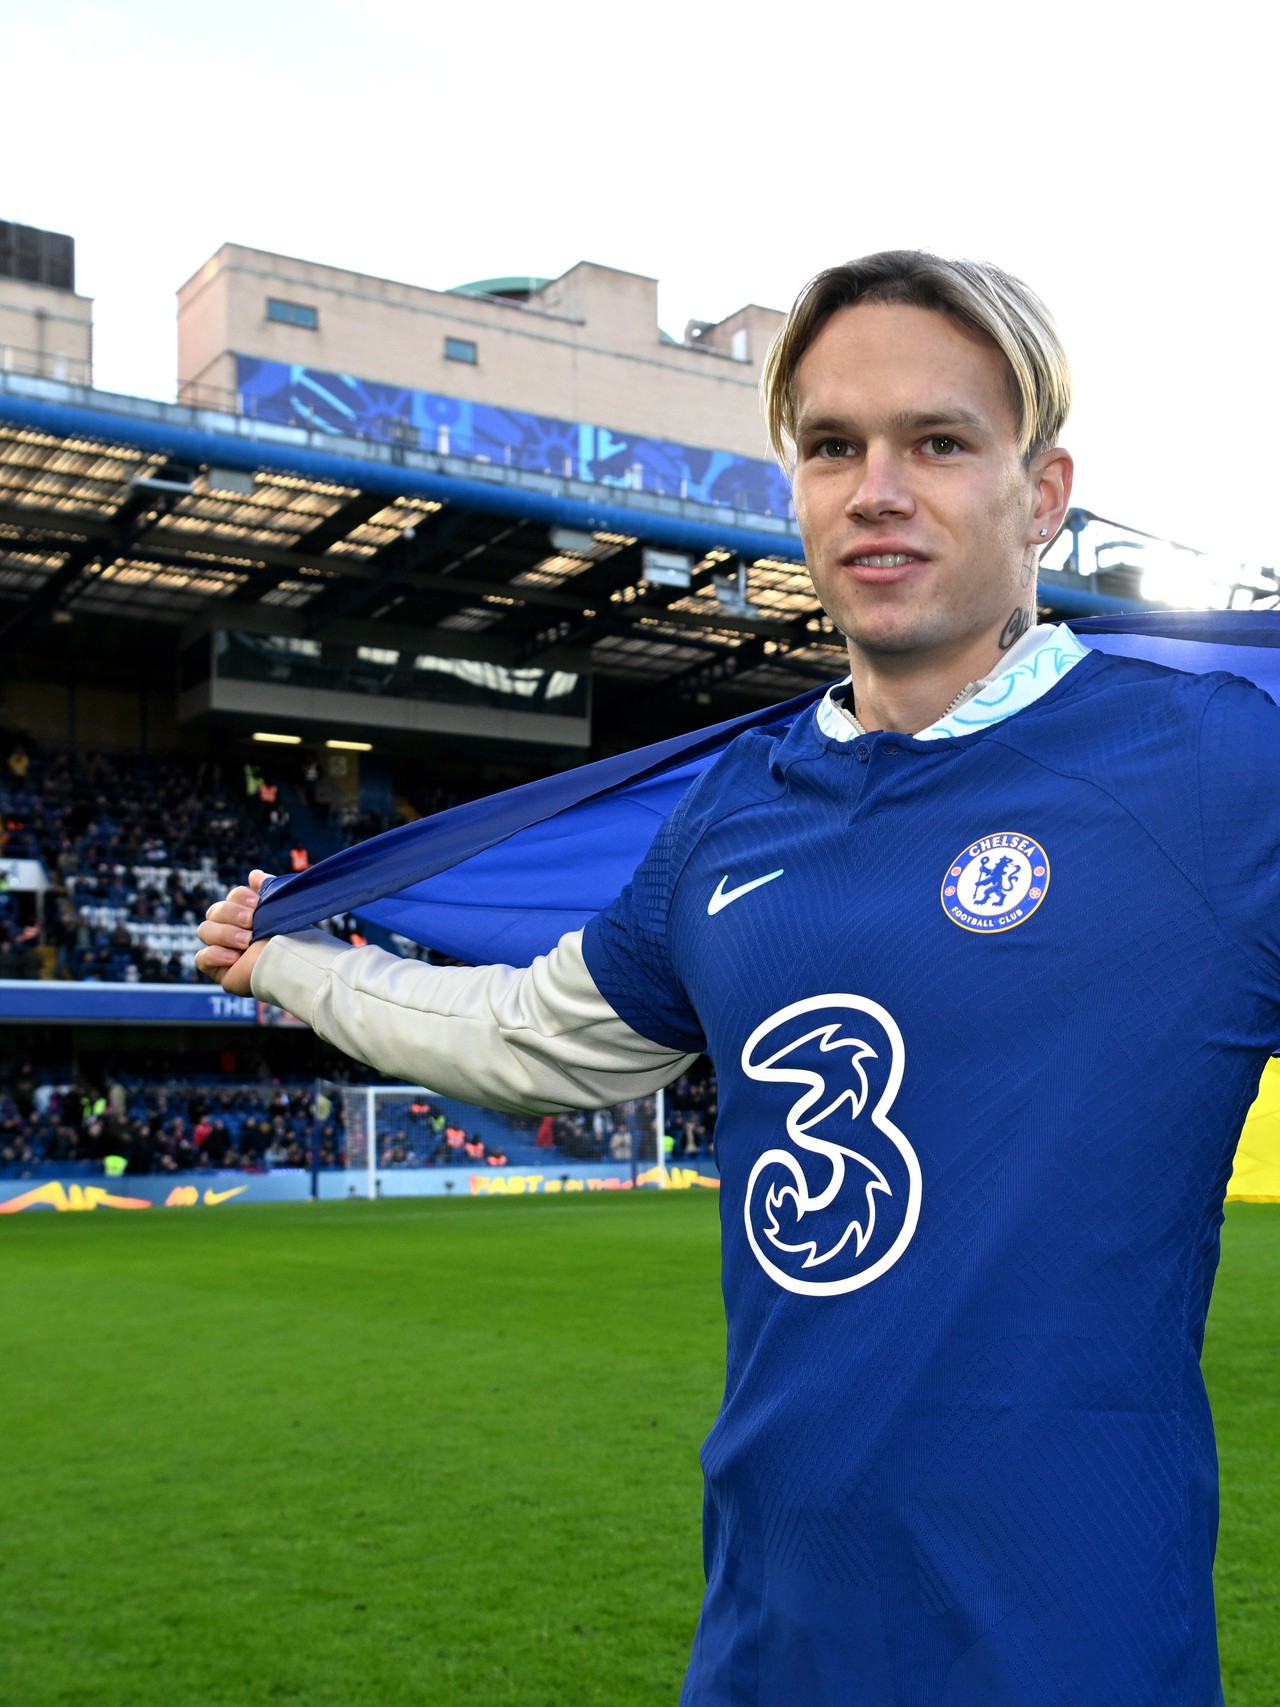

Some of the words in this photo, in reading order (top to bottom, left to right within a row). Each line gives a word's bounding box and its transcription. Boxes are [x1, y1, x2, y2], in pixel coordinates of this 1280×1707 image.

[968, 835, 1037, 858] CHELSEA
[951, 905, 994, 927] FOOTBALL
[998, 908, 1023, 925] CLUB
[209, 996, 256, 1017] THE
[469, 1175, 543, 1195] FAST
